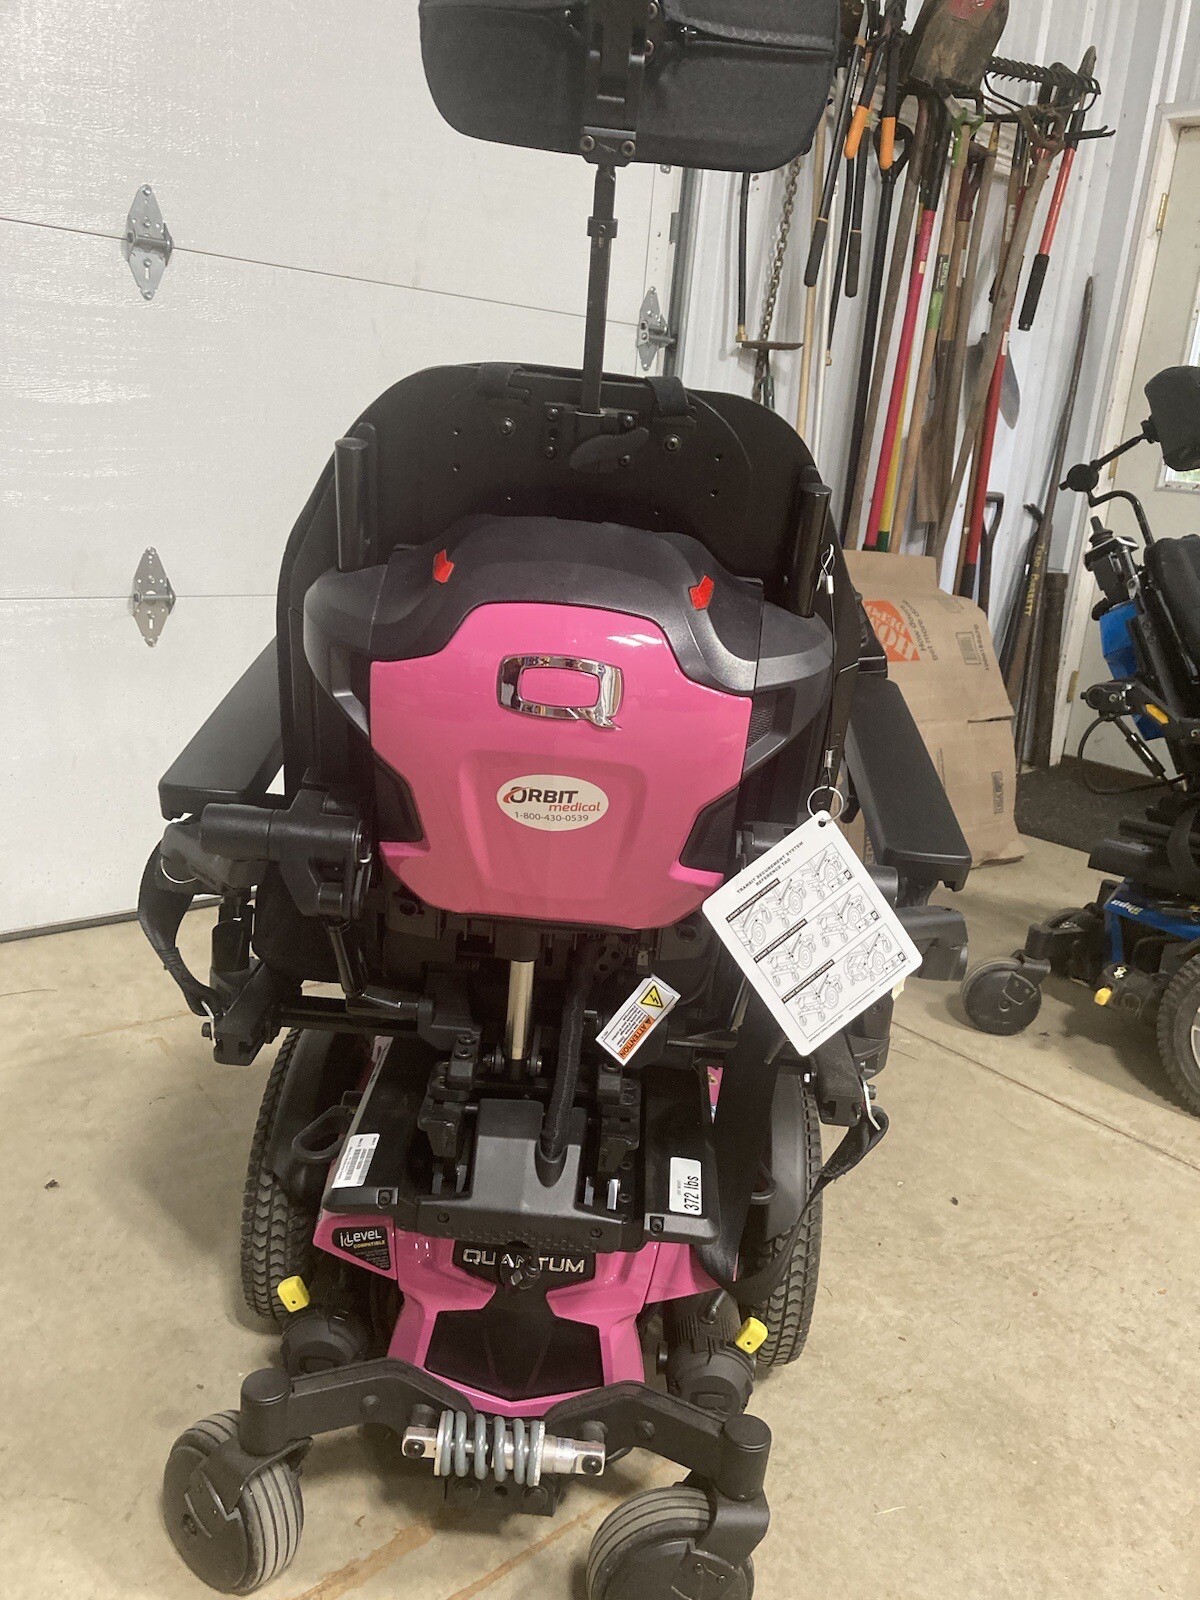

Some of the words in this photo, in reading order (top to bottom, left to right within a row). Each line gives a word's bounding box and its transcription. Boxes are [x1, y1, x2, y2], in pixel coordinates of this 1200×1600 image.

[503, 786, 578, 804] ORBIT
[549, 802, 601, 812] medical
[515, 812, 589, 822] 1-800-430-0539
[736, 877, 756, 894] TRANSIT
[756, 854, 786, 879] SECUREMENT
[785, 841, 804, 856] SYSTEM
[755, 865, 782, 886] REFERENCE
[781, 857, 791, 866] TAG
[619, 1024, 648, 1058] ATTENTION
[683, 1175, 700, 1191] lbs
[683, 1192, 700, 1211] 372
